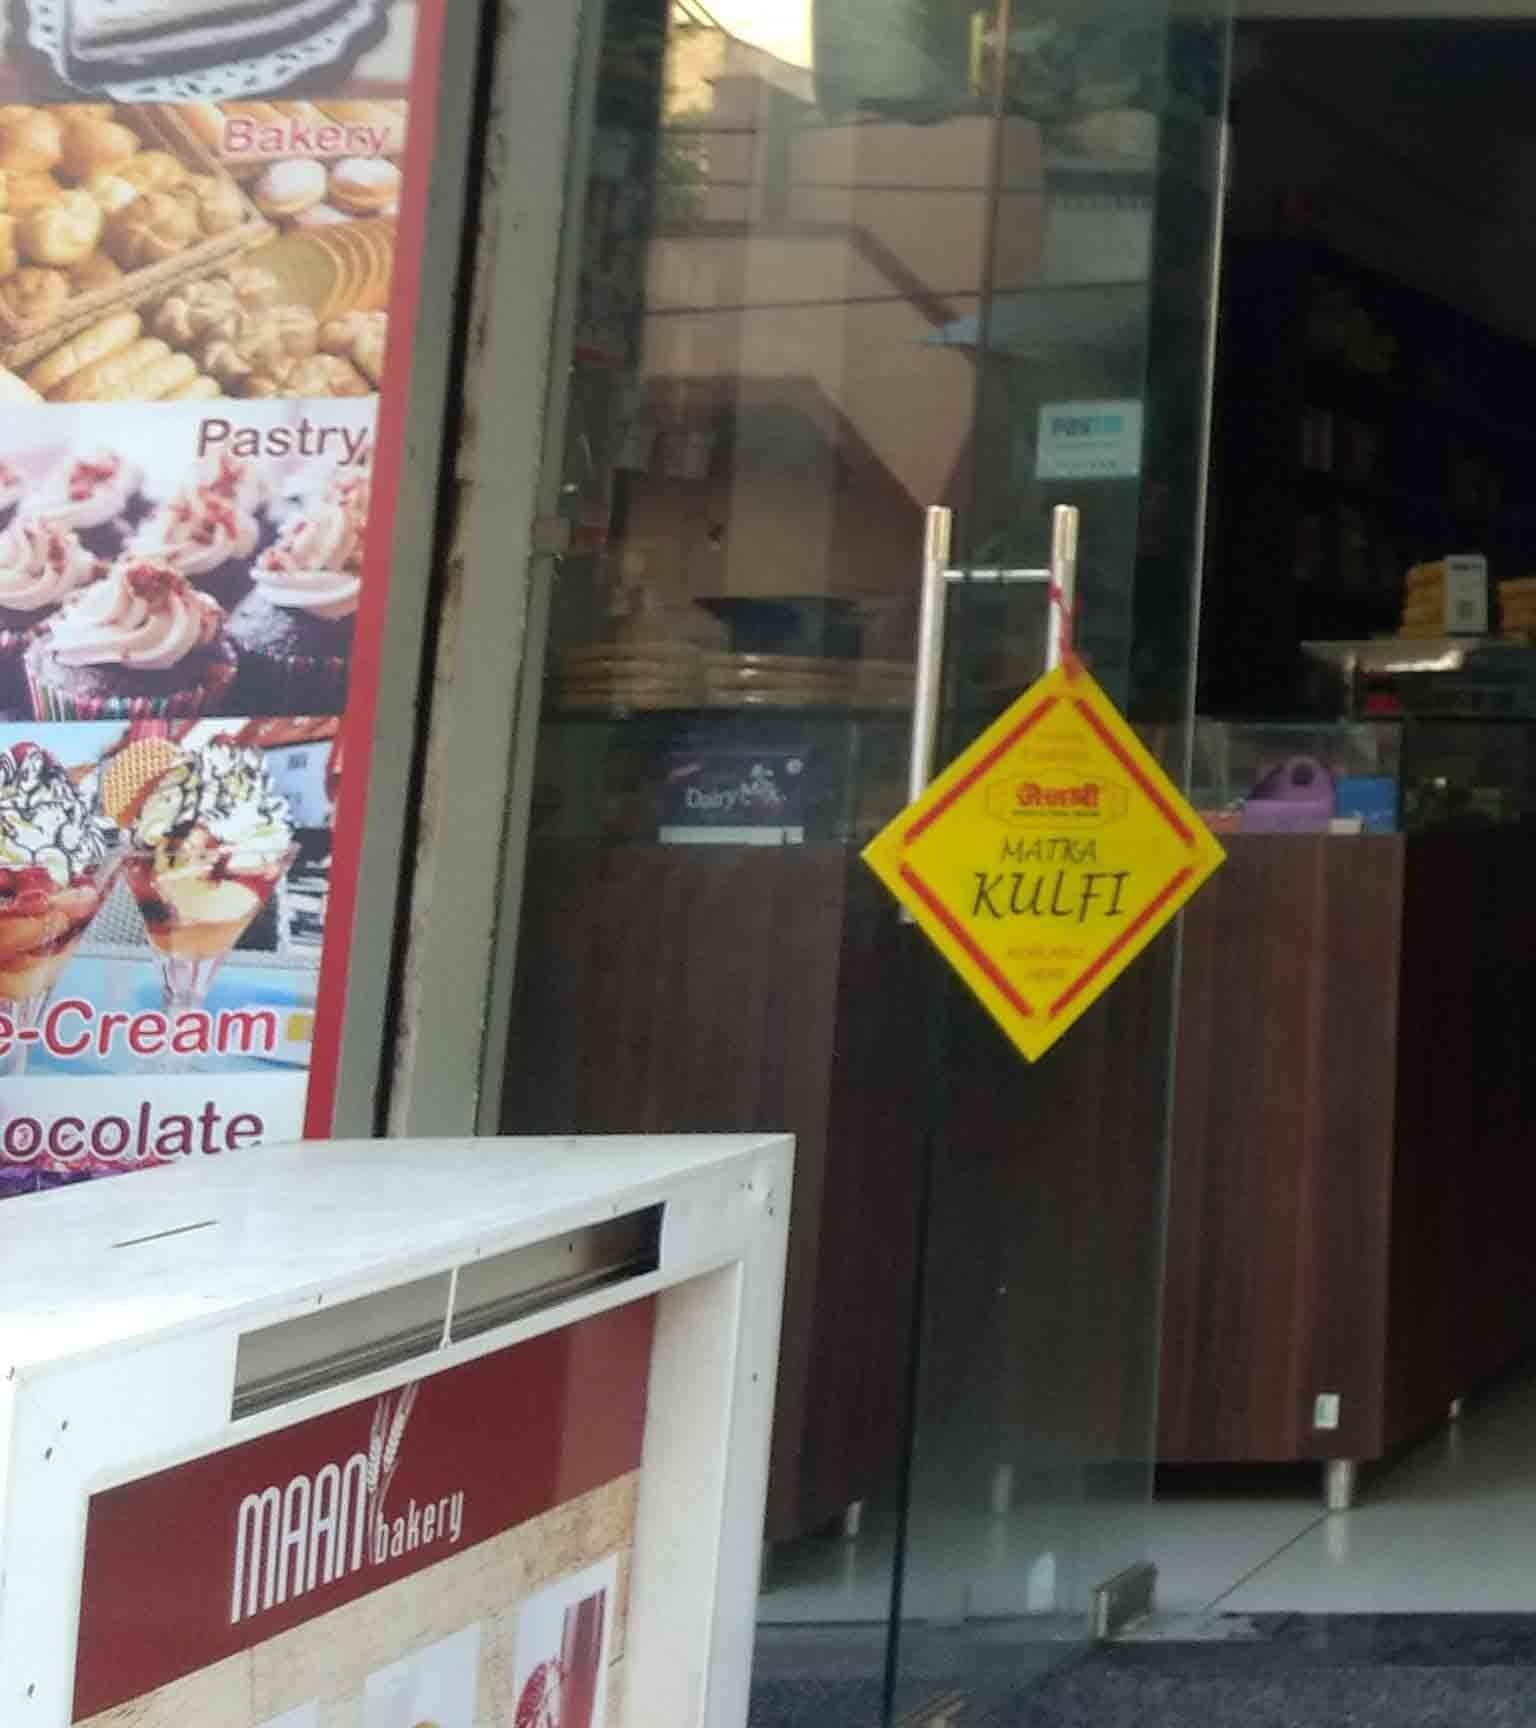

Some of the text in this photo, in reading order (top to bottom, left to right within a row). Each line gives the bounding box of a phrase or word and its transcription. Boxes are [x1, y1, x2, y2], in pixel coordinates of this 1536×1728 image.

[222, 117, 393, 154] Bakery
[196, 418, 368, 467] Pastry
[1001, 838, 1098, 864] MATKA
[972, 872, 1130, 922] KULFI
[231, 1452, 464, 1623] MAAN bakery
